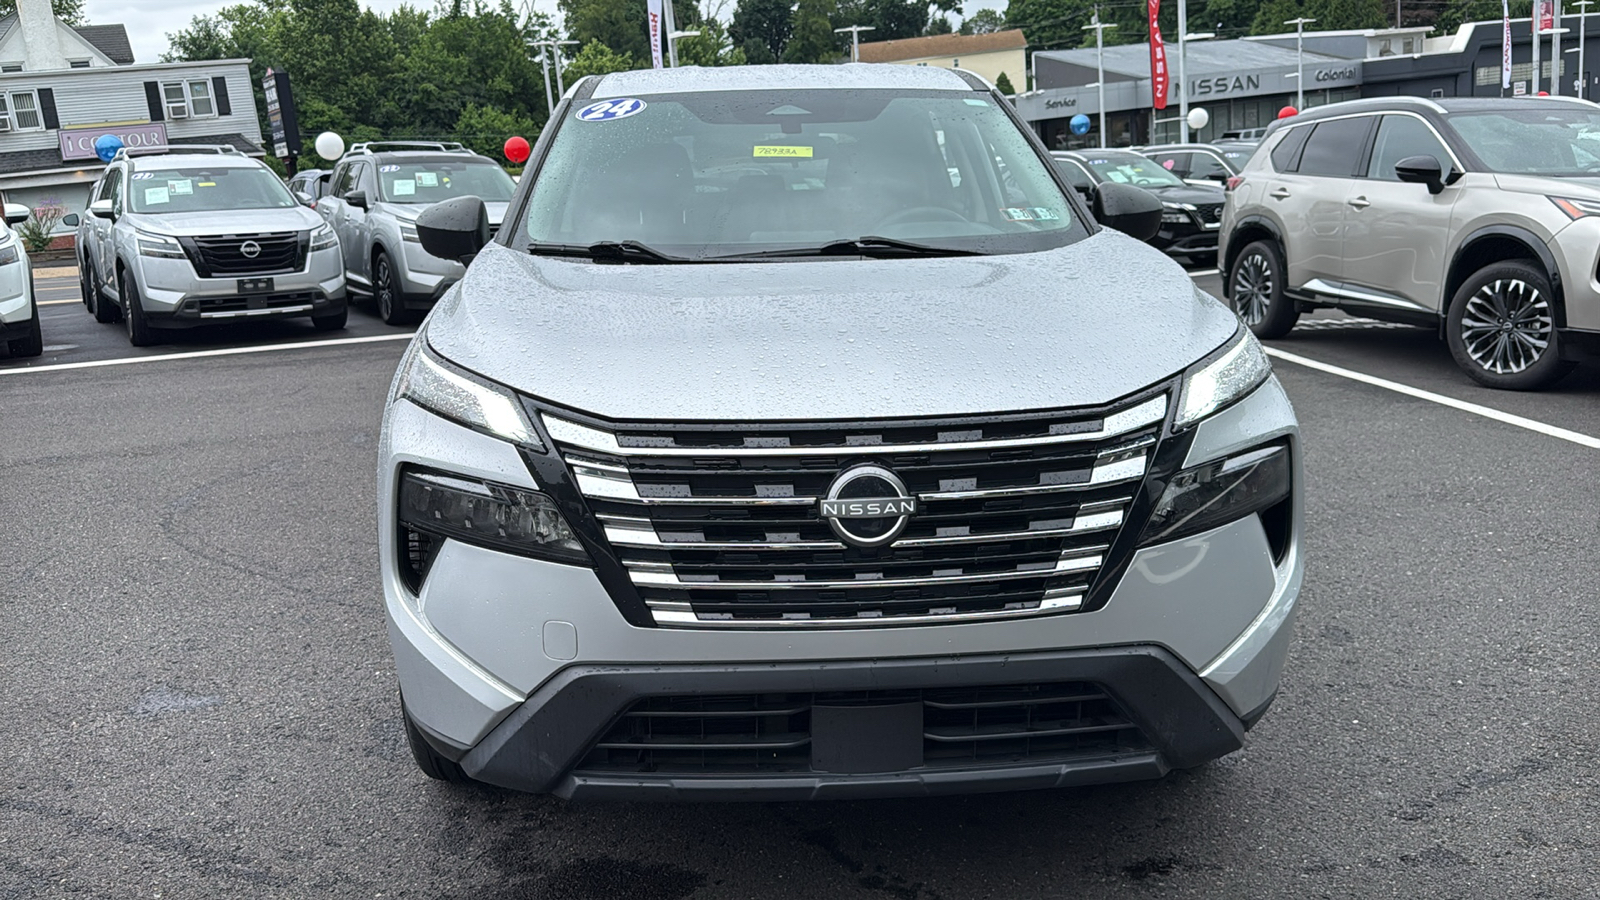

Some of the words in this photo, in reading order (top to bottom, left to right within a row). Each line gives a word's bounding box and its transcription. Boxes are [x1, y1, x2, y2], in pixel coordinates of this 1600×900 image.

[1315, 67, 1357, 82] Colonial
[583, 99, 634, 119] 24
[1045, 97, 1077, 109] Service
[78, 131, 161, 151] COTOUR
[823, 501, 914, 515] NISSAN
